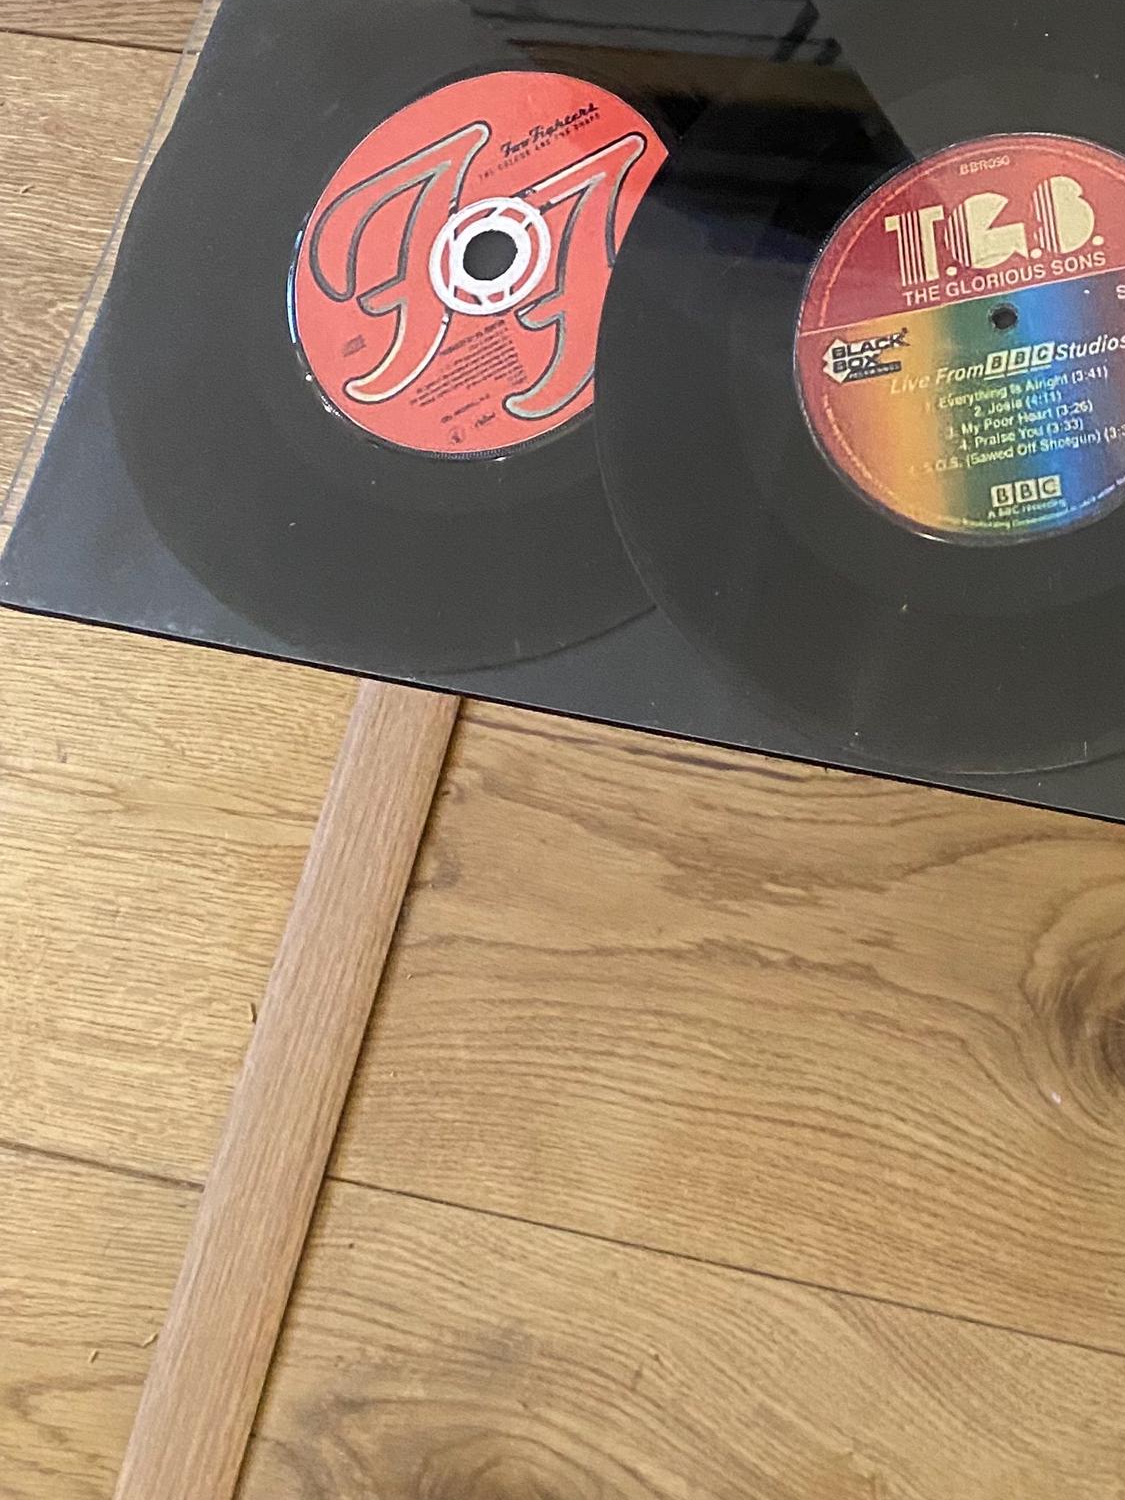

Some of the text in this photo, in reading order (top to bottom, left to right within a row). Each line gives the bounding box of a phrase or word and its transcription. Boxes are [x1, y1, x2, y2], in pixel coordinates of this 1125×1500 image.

[903, 250, 1106, 306] THE GLORIOUS SONS
[831, 331, 905, 360] BLACK
[832, 350, 881, 373] BOX
[889, 371, 930, 395] Live
[934, 360, 984, 385] From
[984, 342, 1054, 374] BBC
[938, 364, 1108, 411] Everything Alright (3:41)
[983, 414, 1014, 430] Poor
[1018, 407, 1052, 423] Heart
[987, 397, 1023, 414] Josie
[966, 446, 1013, 467] (Sawed
[1016, 441, 1036, 455] Off
[1039, 429, 1101, 453] Shotgun)
[974, 424, 1044, 447] Praise You
[992, 476, 1060, 506] BBC
